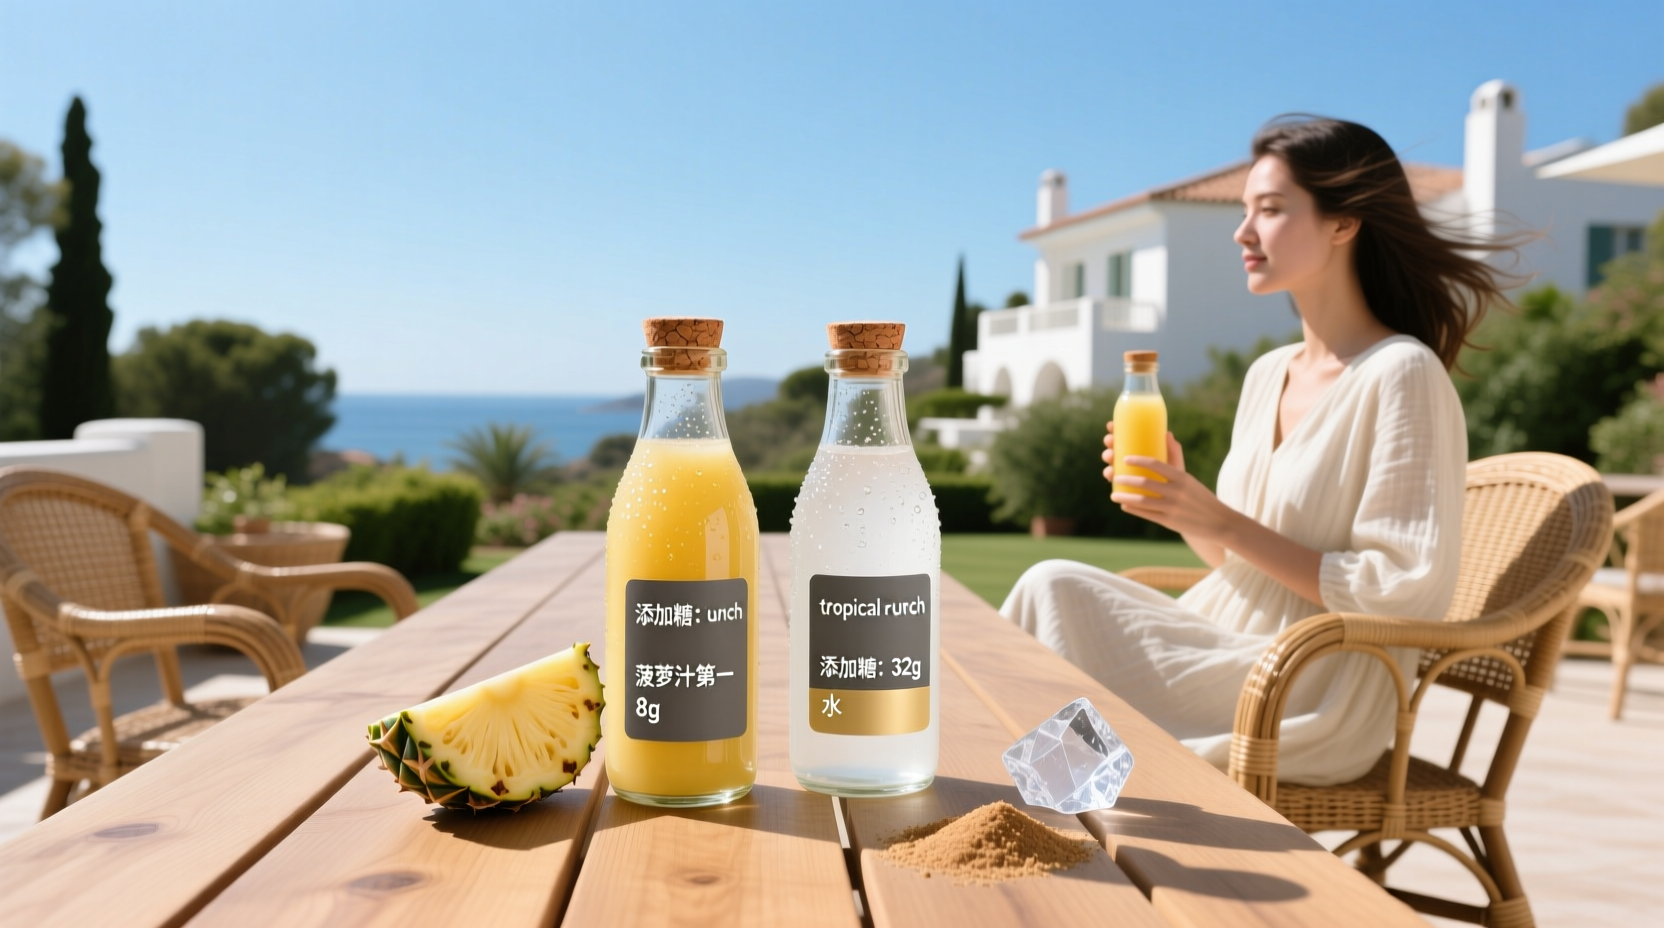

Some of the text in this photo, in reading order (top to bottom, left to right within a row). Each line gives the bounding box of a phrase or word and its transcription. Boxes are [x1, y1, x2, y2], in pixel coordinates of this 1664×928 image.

[819, 597, 881, 621] tropical
[891, 656, 921, 680] 32g
[635, 696, 660, 724] 8g
[821, 693, 842, 717] 水
